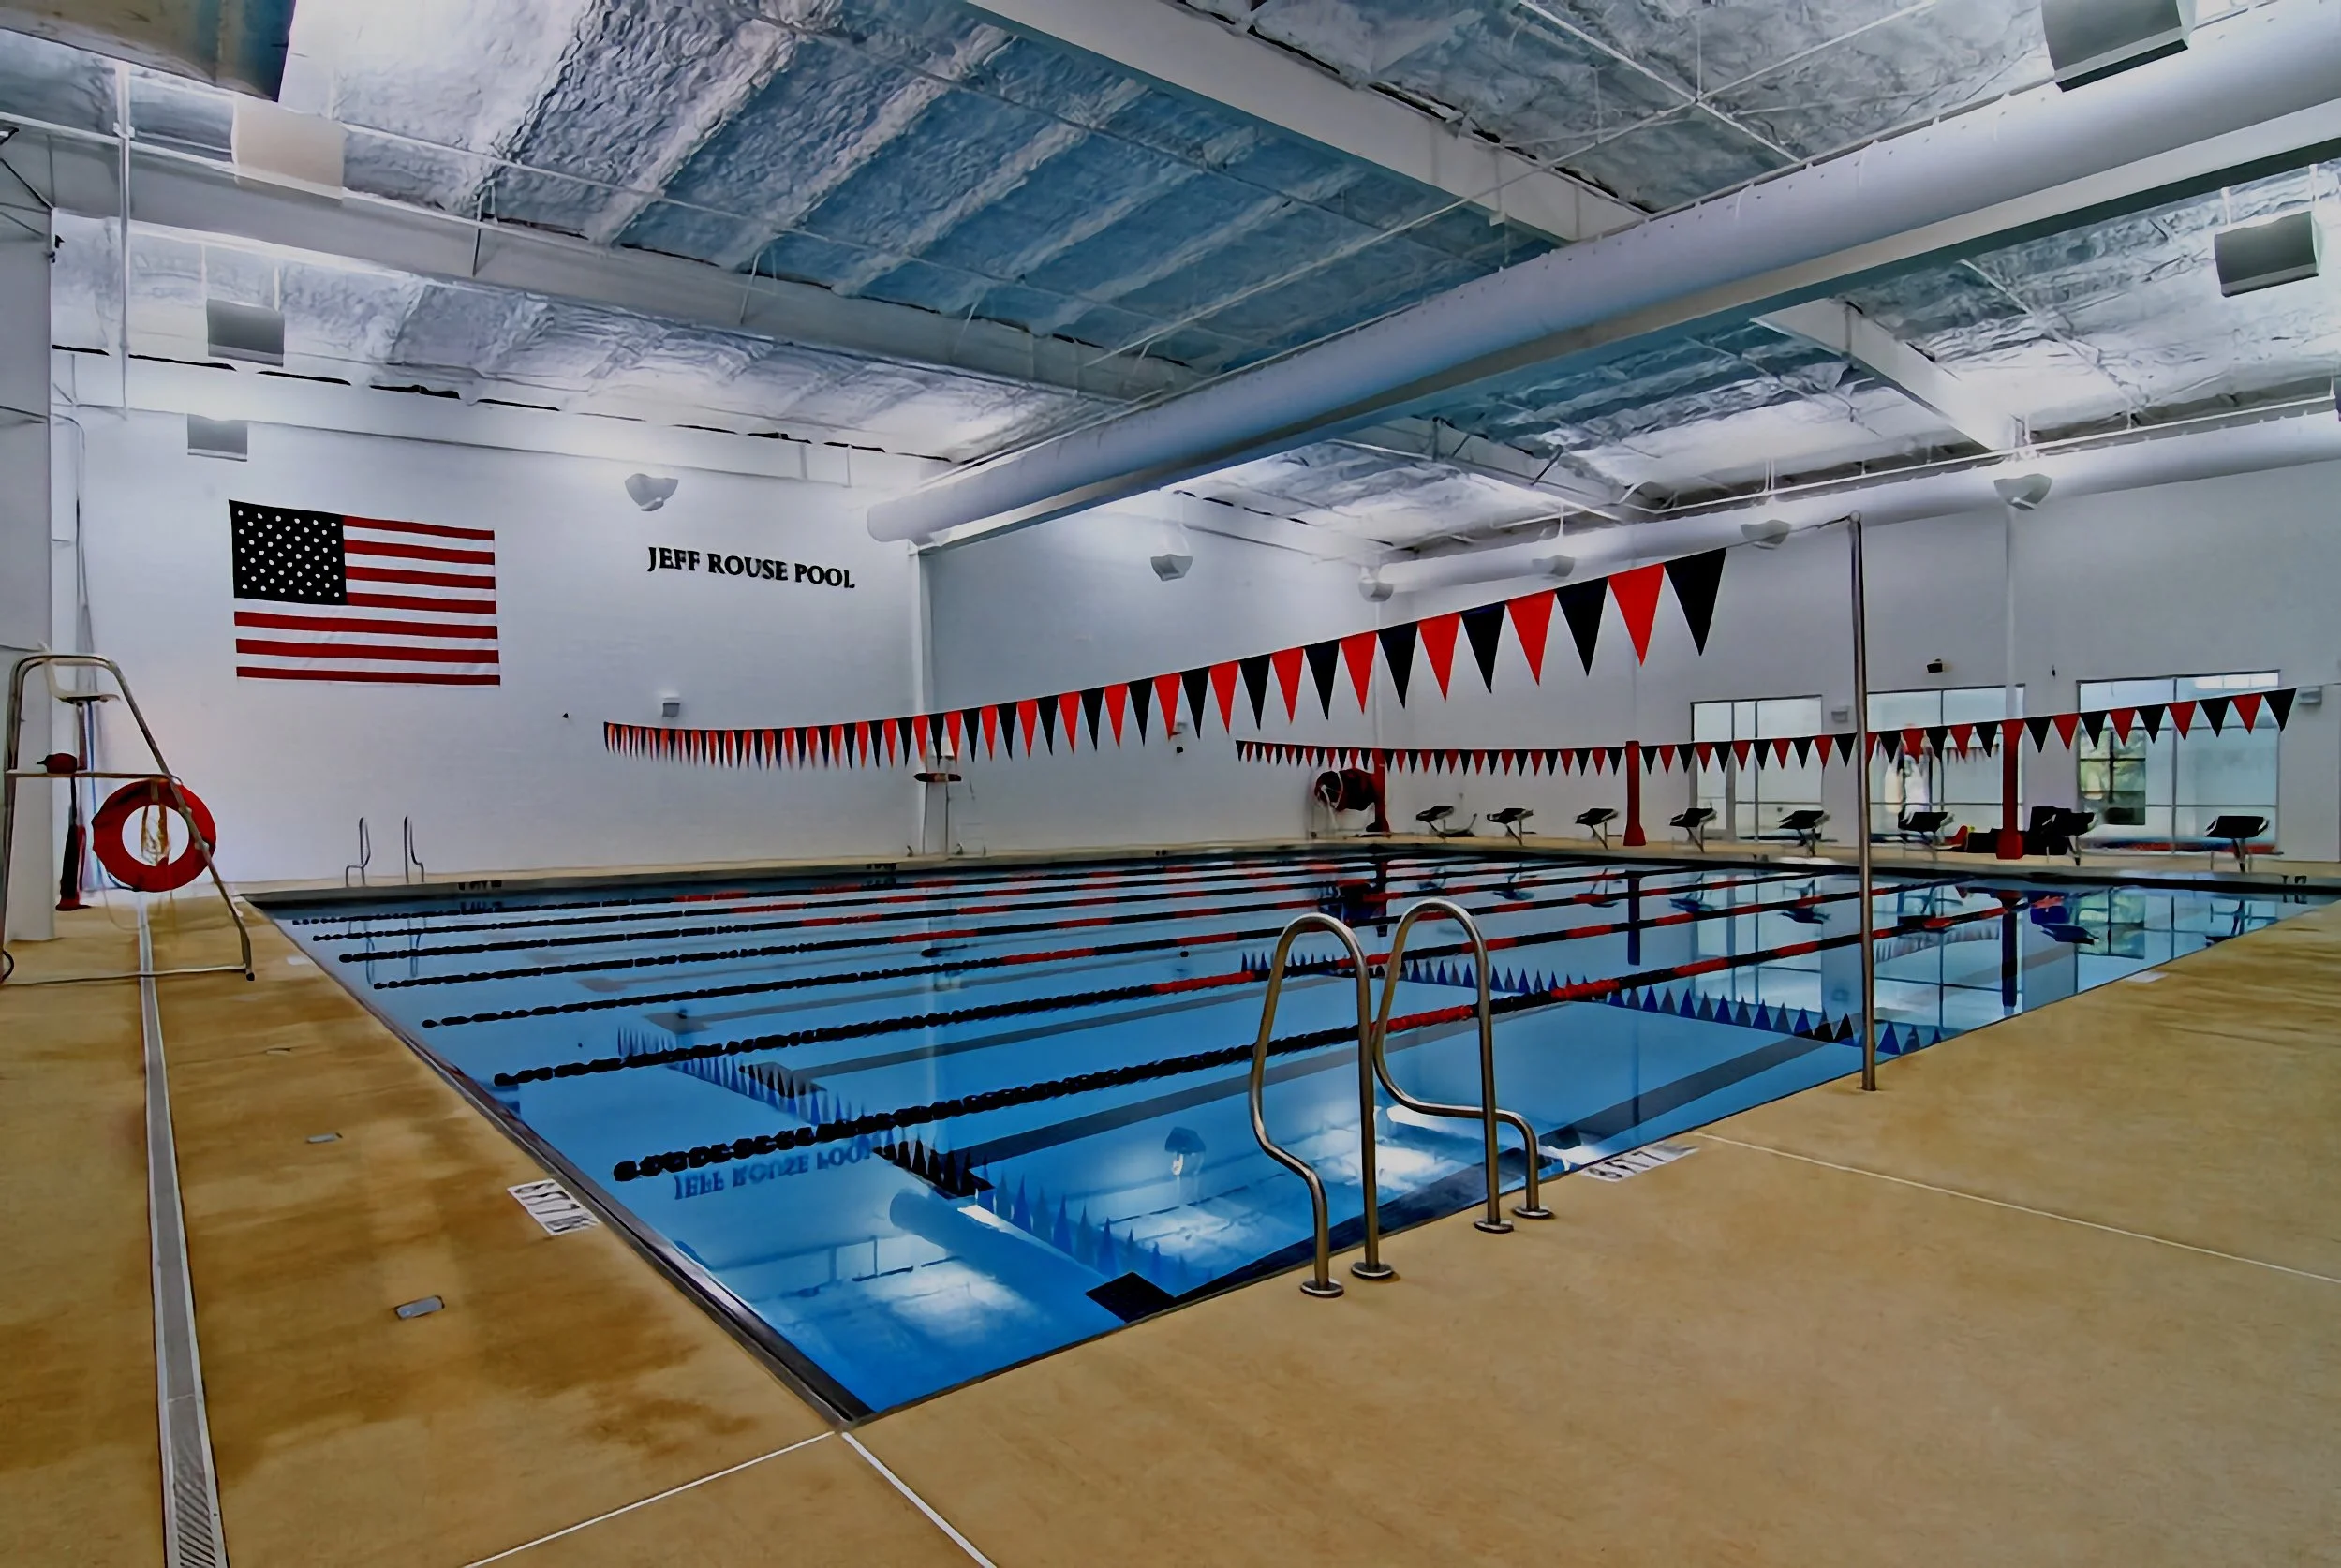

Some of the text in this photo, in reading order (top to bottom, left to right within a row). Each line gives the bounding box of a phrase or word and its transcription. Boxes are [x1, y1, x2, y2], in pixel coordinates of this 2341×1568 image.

[647, 546, 855, 589] JEFF ROUSE POOL
